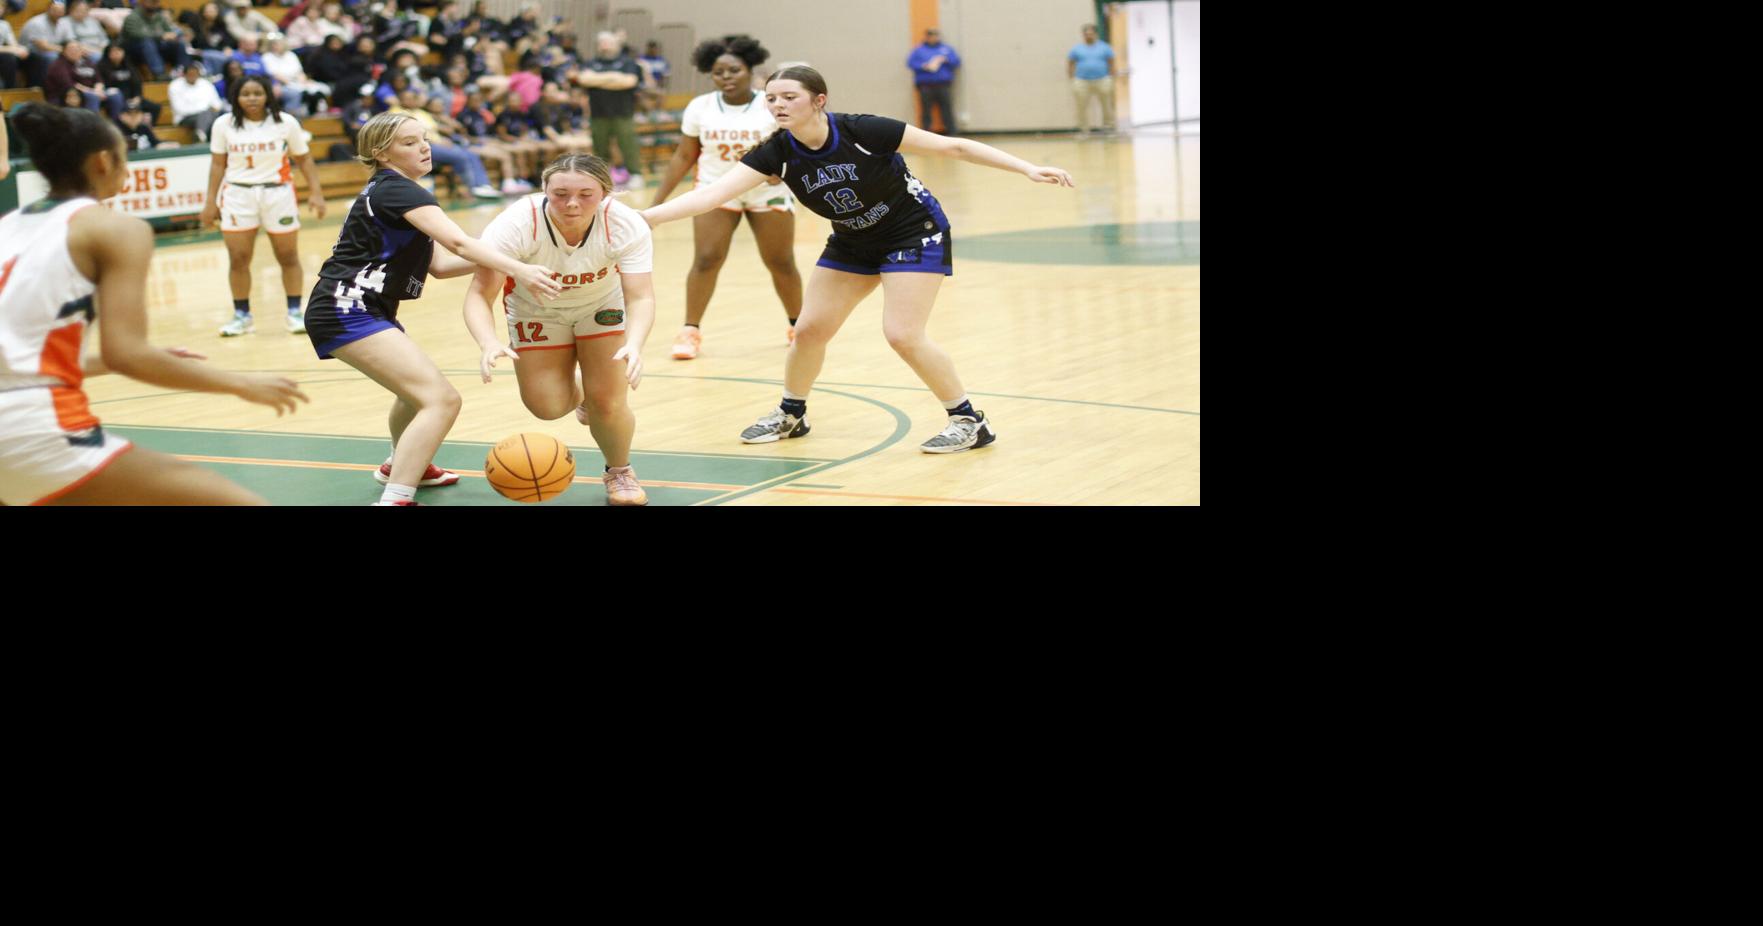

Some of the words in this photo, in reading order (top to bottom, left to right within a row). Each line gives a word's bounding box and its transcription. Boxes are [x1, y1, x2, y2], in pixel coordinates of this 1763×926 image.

[245, 155, 254, 169] 1
[802, 164, 860, 193] LADY
[824, 187, 864, 214] 12
[838, 201, 890, 230] TANS
[515, 321, 549, 343] 12
